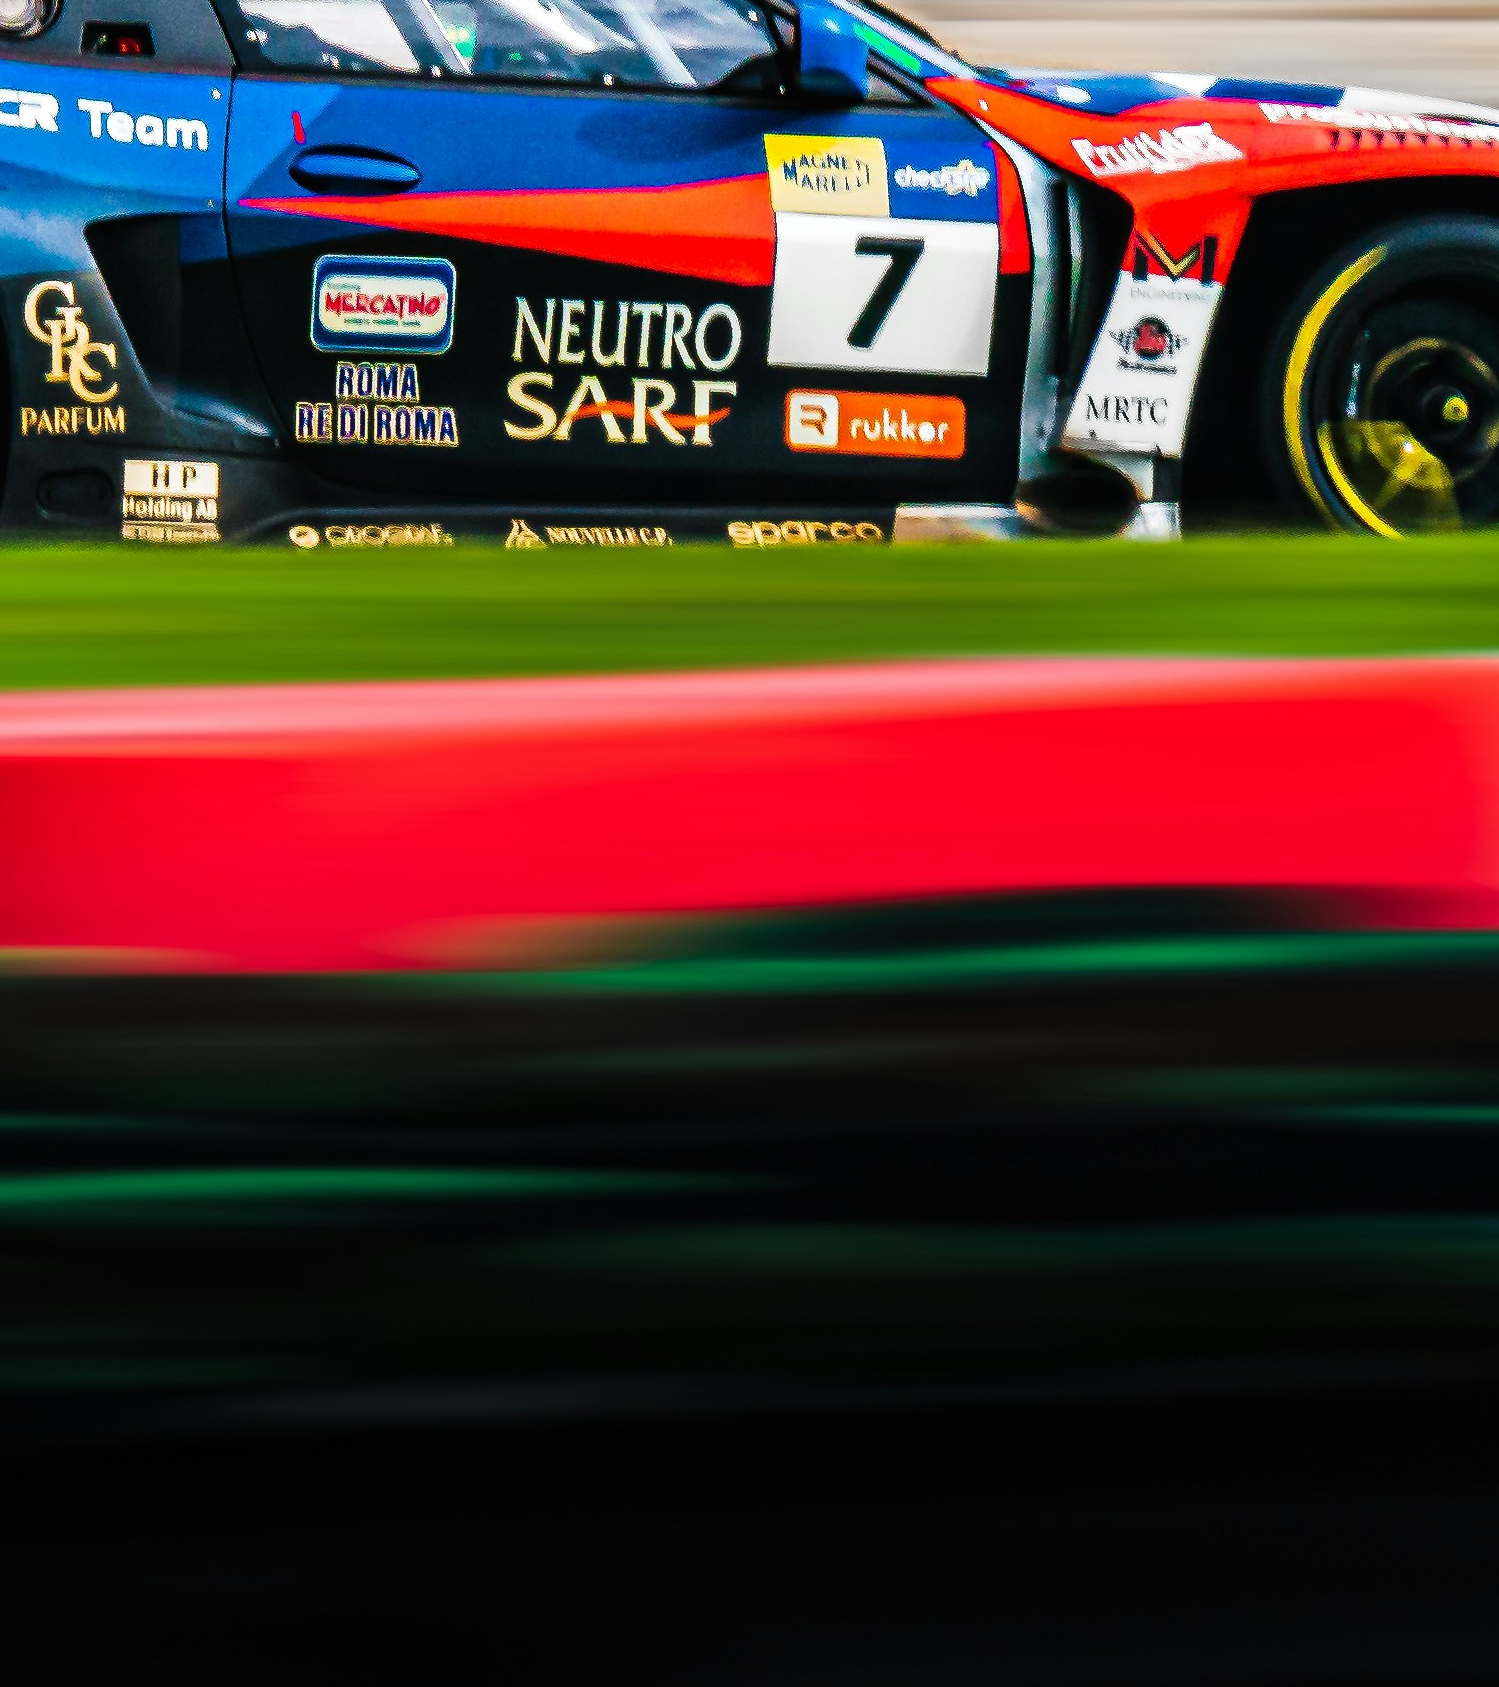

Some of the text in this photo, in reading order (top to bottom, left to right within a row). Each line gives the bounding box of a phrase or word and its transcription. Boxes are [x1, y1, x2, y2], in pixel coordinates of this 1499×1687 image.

[77, 97, 209, 151] Team
[325, 291, 447, 319] MERCATINO
[846, 236, 925, 349] 7
[511, 296, 742, 371] NEUTRO
[336, 362, 419, 403] ROMA
[21, 405, 126, 435] PARFUM
[296, 402, 459, 448] RE DI ROMA
[504, 371, 738, 446] SARF
[1086, 393, 1168, 425] MRTC
[122, 497, 193, 523] Holding
[728, 520, 883, 549] sparco
